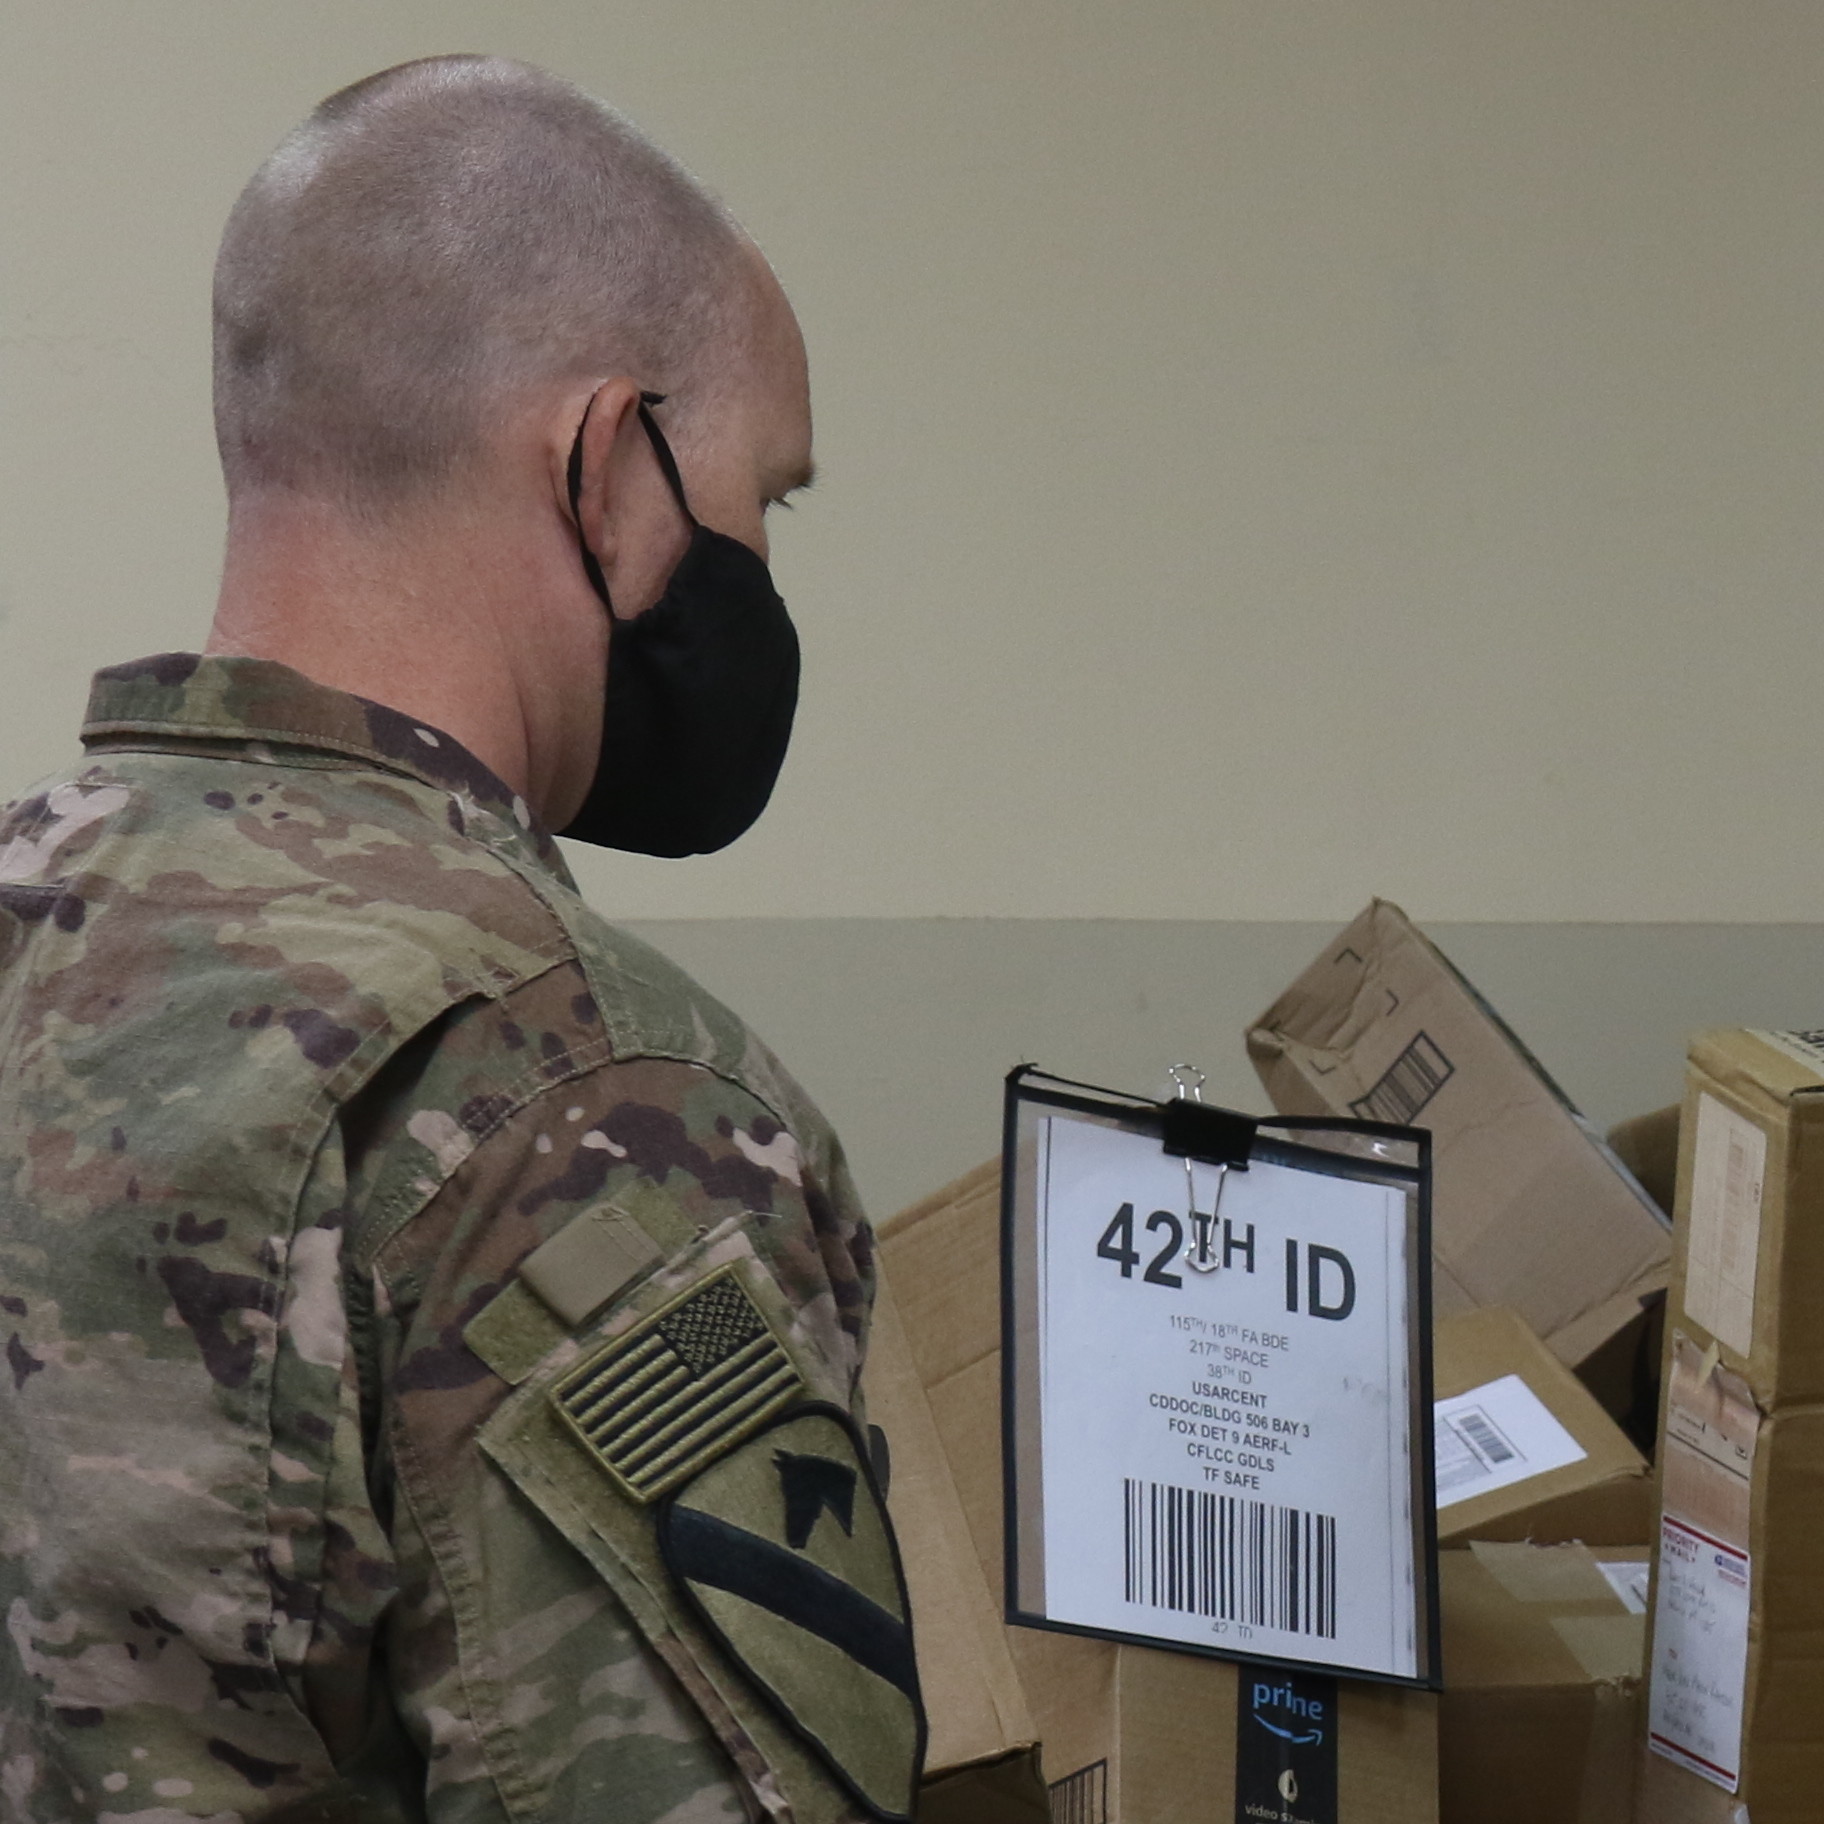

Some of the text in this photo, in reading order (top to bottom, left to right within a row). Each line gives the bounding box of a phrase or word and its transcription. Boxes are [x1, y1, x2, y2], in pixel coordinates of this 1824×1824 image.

[1285, 1237, 1357, 1322] ID
[1261, 1332, 1290, 1351] BDE
[1224, 1346, 1270, 1368] SPACE
[1238, 1370, 1252, 1385] ID
[1192, 1380, 1268, 1409] USARCENT
[1168, 1417, 1197, 1437] FOX
[1201, 1424, 1228, 1442] DET
[1231, 1430, 1241, 1445] 9
[1246, 1413, 1269, 1430] 506
[1272, 1417, 1300, 1436] BAY
[1302, 1424, 1311, 1439] 3
[1187, 1442, 1275, 1473] CFLCC GDLS
[1202, 1466, 1261, 1491] TF SAFE
[1244, 1803, 1279, 1821] video
